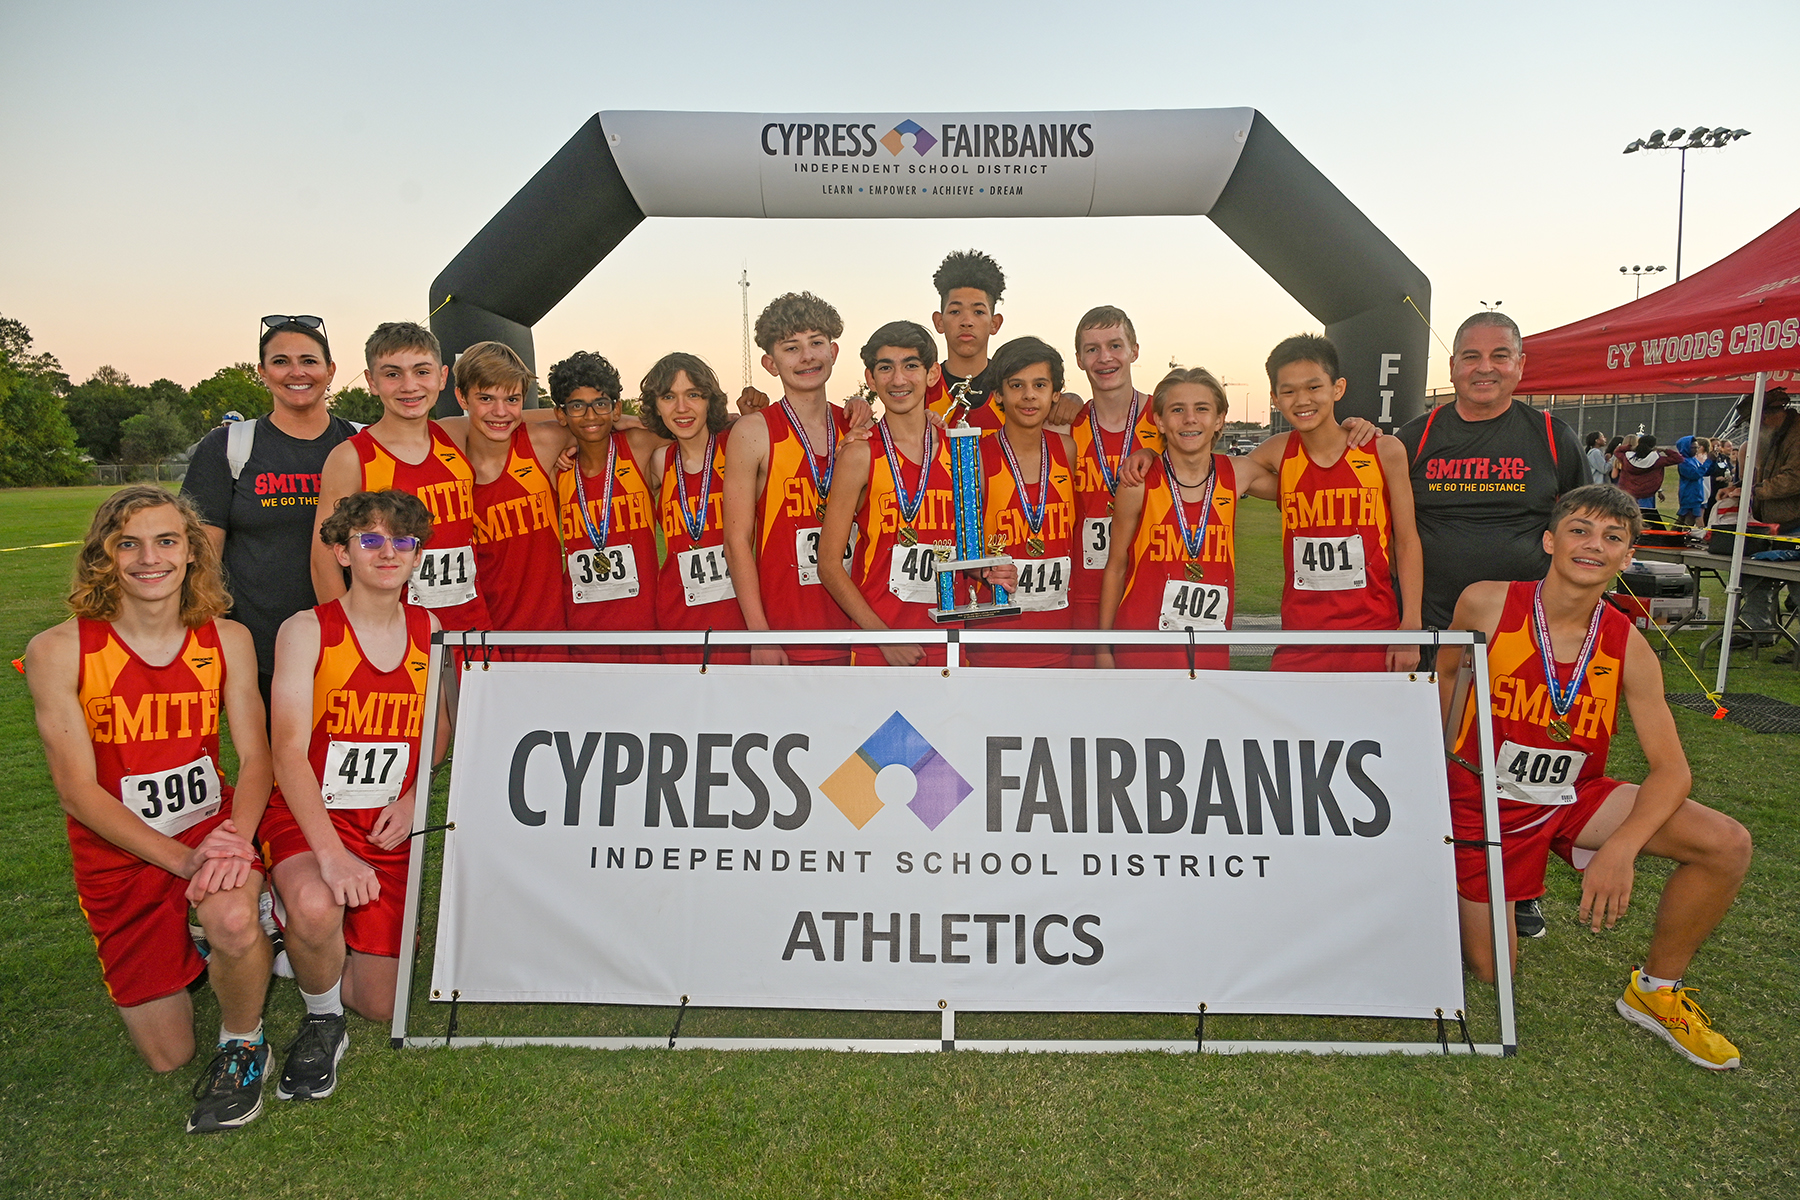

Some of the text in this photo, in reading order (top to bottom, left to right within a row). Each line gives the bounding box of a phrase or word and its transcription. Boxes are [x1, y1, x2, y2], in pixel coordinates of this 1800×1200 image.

[760, 123, 1095, 158] CYPRESS FAIRBANKS
[794, 163, 1048, 174] INDEPENDENT SCHOOL DISTRICT
[822, 185, 1024, 195] LEARN EMPOWER ACHIEVE DREAM
[1606, 317, 1800, 370] CY WOODS CROS
[1378, 353, 1402, 436] FI
[254, 472, 322, 495] SMITH
[1425, 457, 1490, 480] SMITH
[260, 496, 319, 507] WE GO THE
[417, 479, 473, 525] ITH
[1428, 483, 1526, 492] WE GO THE DISTANCE
[473, 491, 550, 545] MITH
[996, 502, 1070, 547] SMTH
[1284, 487, 1379, 530] SMITH
[988, 533, 1007, 546] 2022
[1302, 541, 1353, 572] 401
[420, 551, 468, 587] 411
[902, 548, 935, 582] 40
[1018, 562, 1063, 594] 414
[1173, 585, 1221, 620] 402
[86, 690, 219, 744] SMITH
[326, 689, 424, 738] SMITH
[338, 748, 398, 784] 417
[1508, 750, 1572, 784] 409
[138, 766, 208, 819] 396
[508, 730, 1391, 839] CYPRESS FAIRBANKS
[590, 847, 1272, 879] INDEPENDENT SCHOOL DISTRICT
[782, 910, 1105, 967] ATHLETICS
